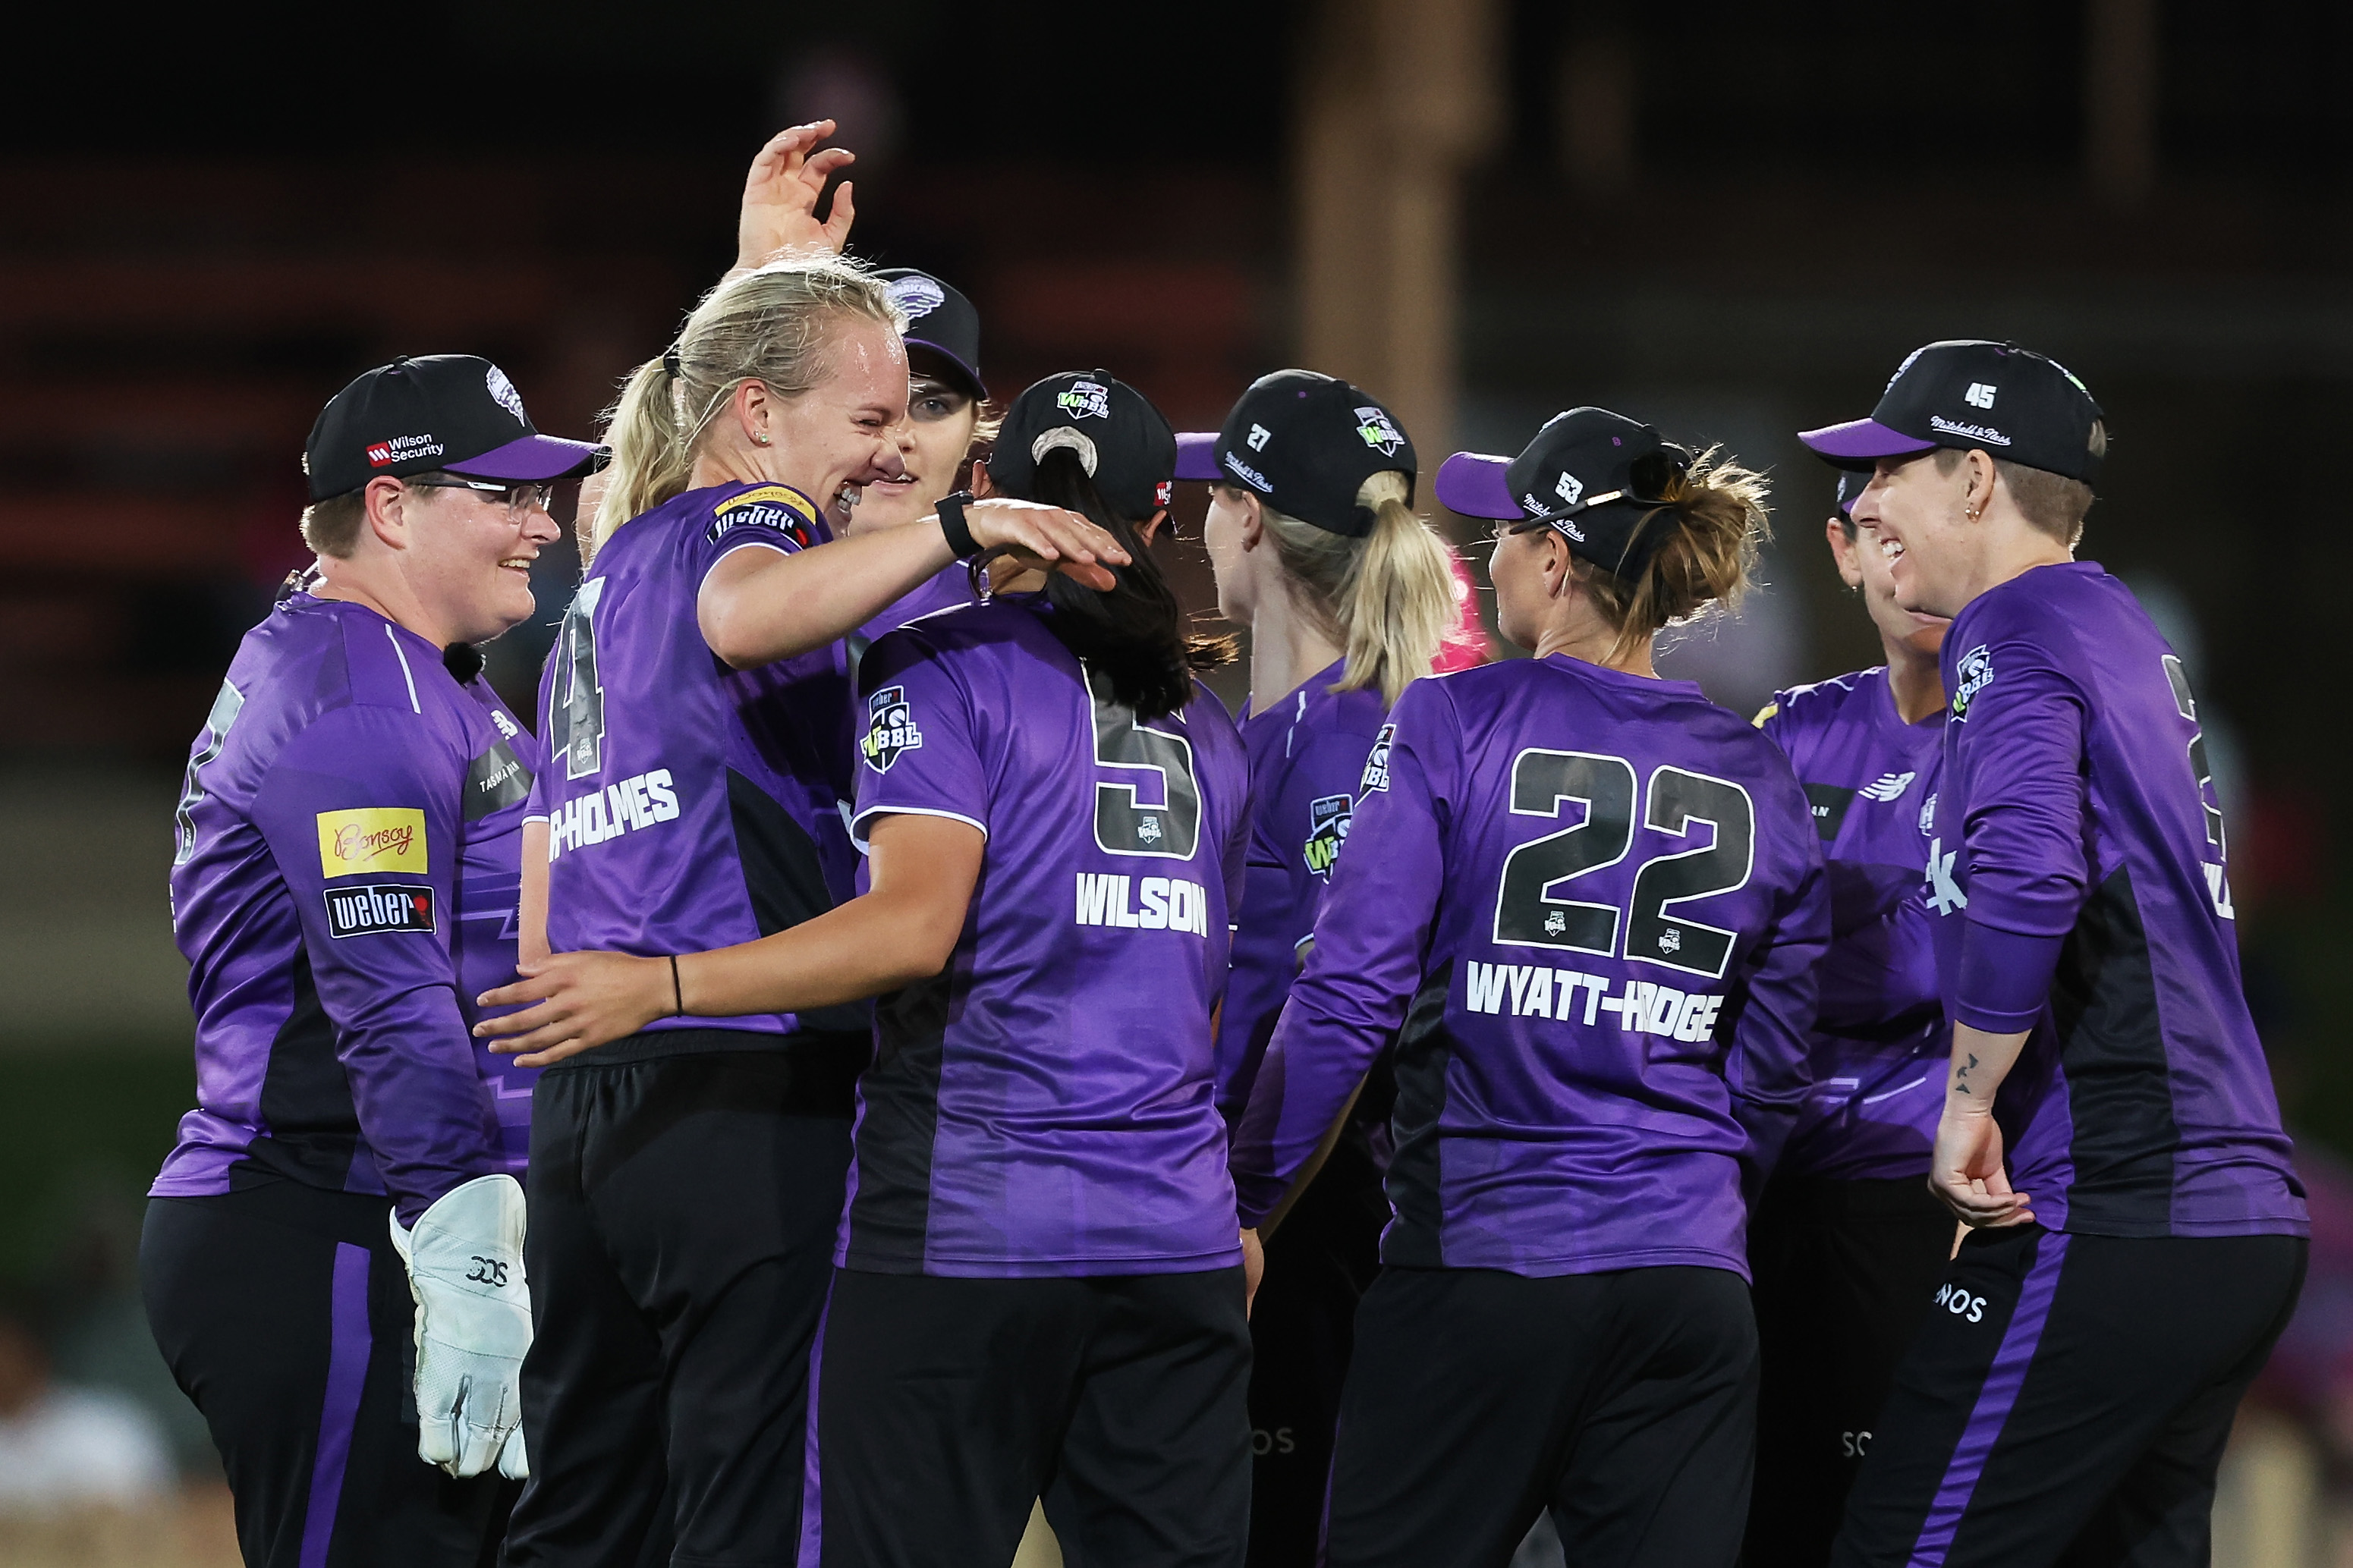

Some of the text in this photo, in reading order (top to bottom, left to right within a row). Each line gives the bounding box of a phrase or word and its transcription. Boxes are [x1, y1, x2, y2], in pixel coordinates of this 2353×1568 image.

[1059, 393, 1108, 416] WBBL
[1965, 382, 1997, 410] 45
[1247, 423, 1272, 453] 27
[1930, 416, 1978, 435] Mitchell
[1975, 427, 1985, 437] &
[388, 433, 433, 451] Wilson
[390, 443, 444, 463] Security
[1555, 471, 1584, 505] 53
[334, 824, 414, 860] Bonsoy
[1492, 747, 1755, 979] 22
[332, 886, 415, 930] weber
[1076, 872, 1207, 938] WILSON
